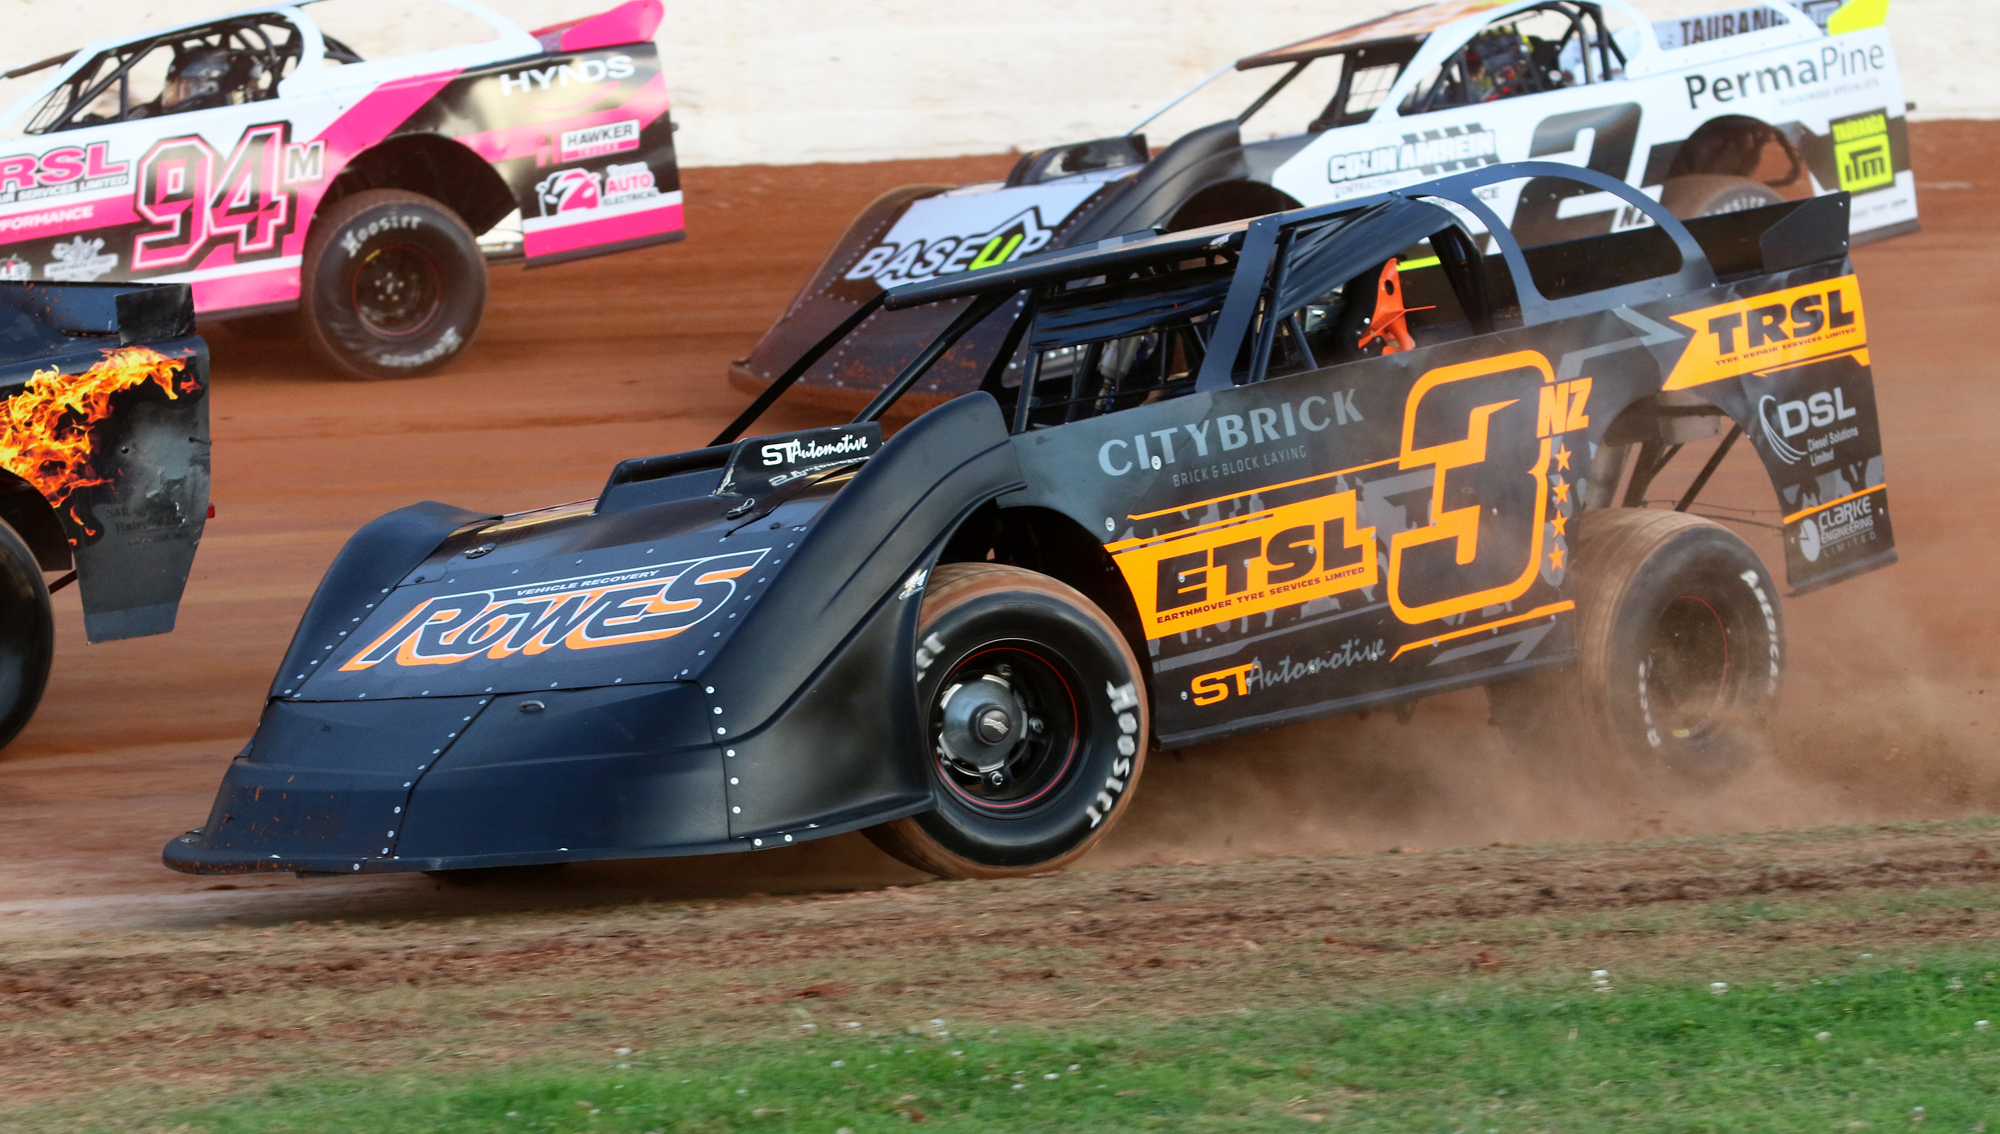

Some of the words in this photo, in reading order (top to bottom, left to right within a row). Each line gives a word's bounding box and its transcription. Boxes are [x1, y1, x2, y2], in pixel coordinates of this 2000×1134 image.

[500, 55, 635, 96] HYNDS
[1684, 42, 1885, 109] PermaPine
[567, 124, 633, 147] HAWKER
[608, 173, 652, 193] AUTO
[1329, 145, 1398, 183] COLIN
[1507, 102, 1643, 249] 2
[18, 183, 77, 200] SERVICES
[79, 175, 128, 192] LIMITED
[131, 121, 290, 271] 94
[283, 139, 326, 185] M
[1708, 289, 1855, 356] TRSL
[1715, 355, 1740, 366] TYRE
[1743, 346, 1778, 359] REPAIR
[1782, 336, 1822, 350] SERVICES
[1825, 327, 1857, 340] LIMITED
[1098, 388, 1364, 476] CITYBRICK
[1777, 386, 1857, 438] DSL
[791, 434, 868, 463] Automotive
[1807, 436, 1829, 453] Diesel
[1829, 426, 1859, 446] Solutions
[1810, 448, 1835, 467] Limited
[1172, 469, 1209, 488] BRICK
[1211, 465, 1220, 478] &
[1222, 456, 1260, 476] BLOCK
[1263, 445, 1307, 467] LAYING
[1387, 350, 1555, 625] 3
[1536, 377, 1592, 439] NZ
[1821, 515, 1873, 544] ENGINEERING
[1824, 531, 1876, 557] LIMITED
[516, 582, 578, 596] VEHICLE
[580, 569, 660, 588] RECOVERY
[1156, 516, 1364, 613] ETSL
[1156, 599, 1233, 624] EARTHMOVER
[1236, 591, 1266, 604] TYRE
[1269, 577, 1321, 596] SERVICES
[1325, 566, 1365, 582] LIMITED
[1190, 663, 1259, 707] ST
[1247, 638, 1386, 695] Automotive
[1085, 680, 1140, 829] Hoosier
